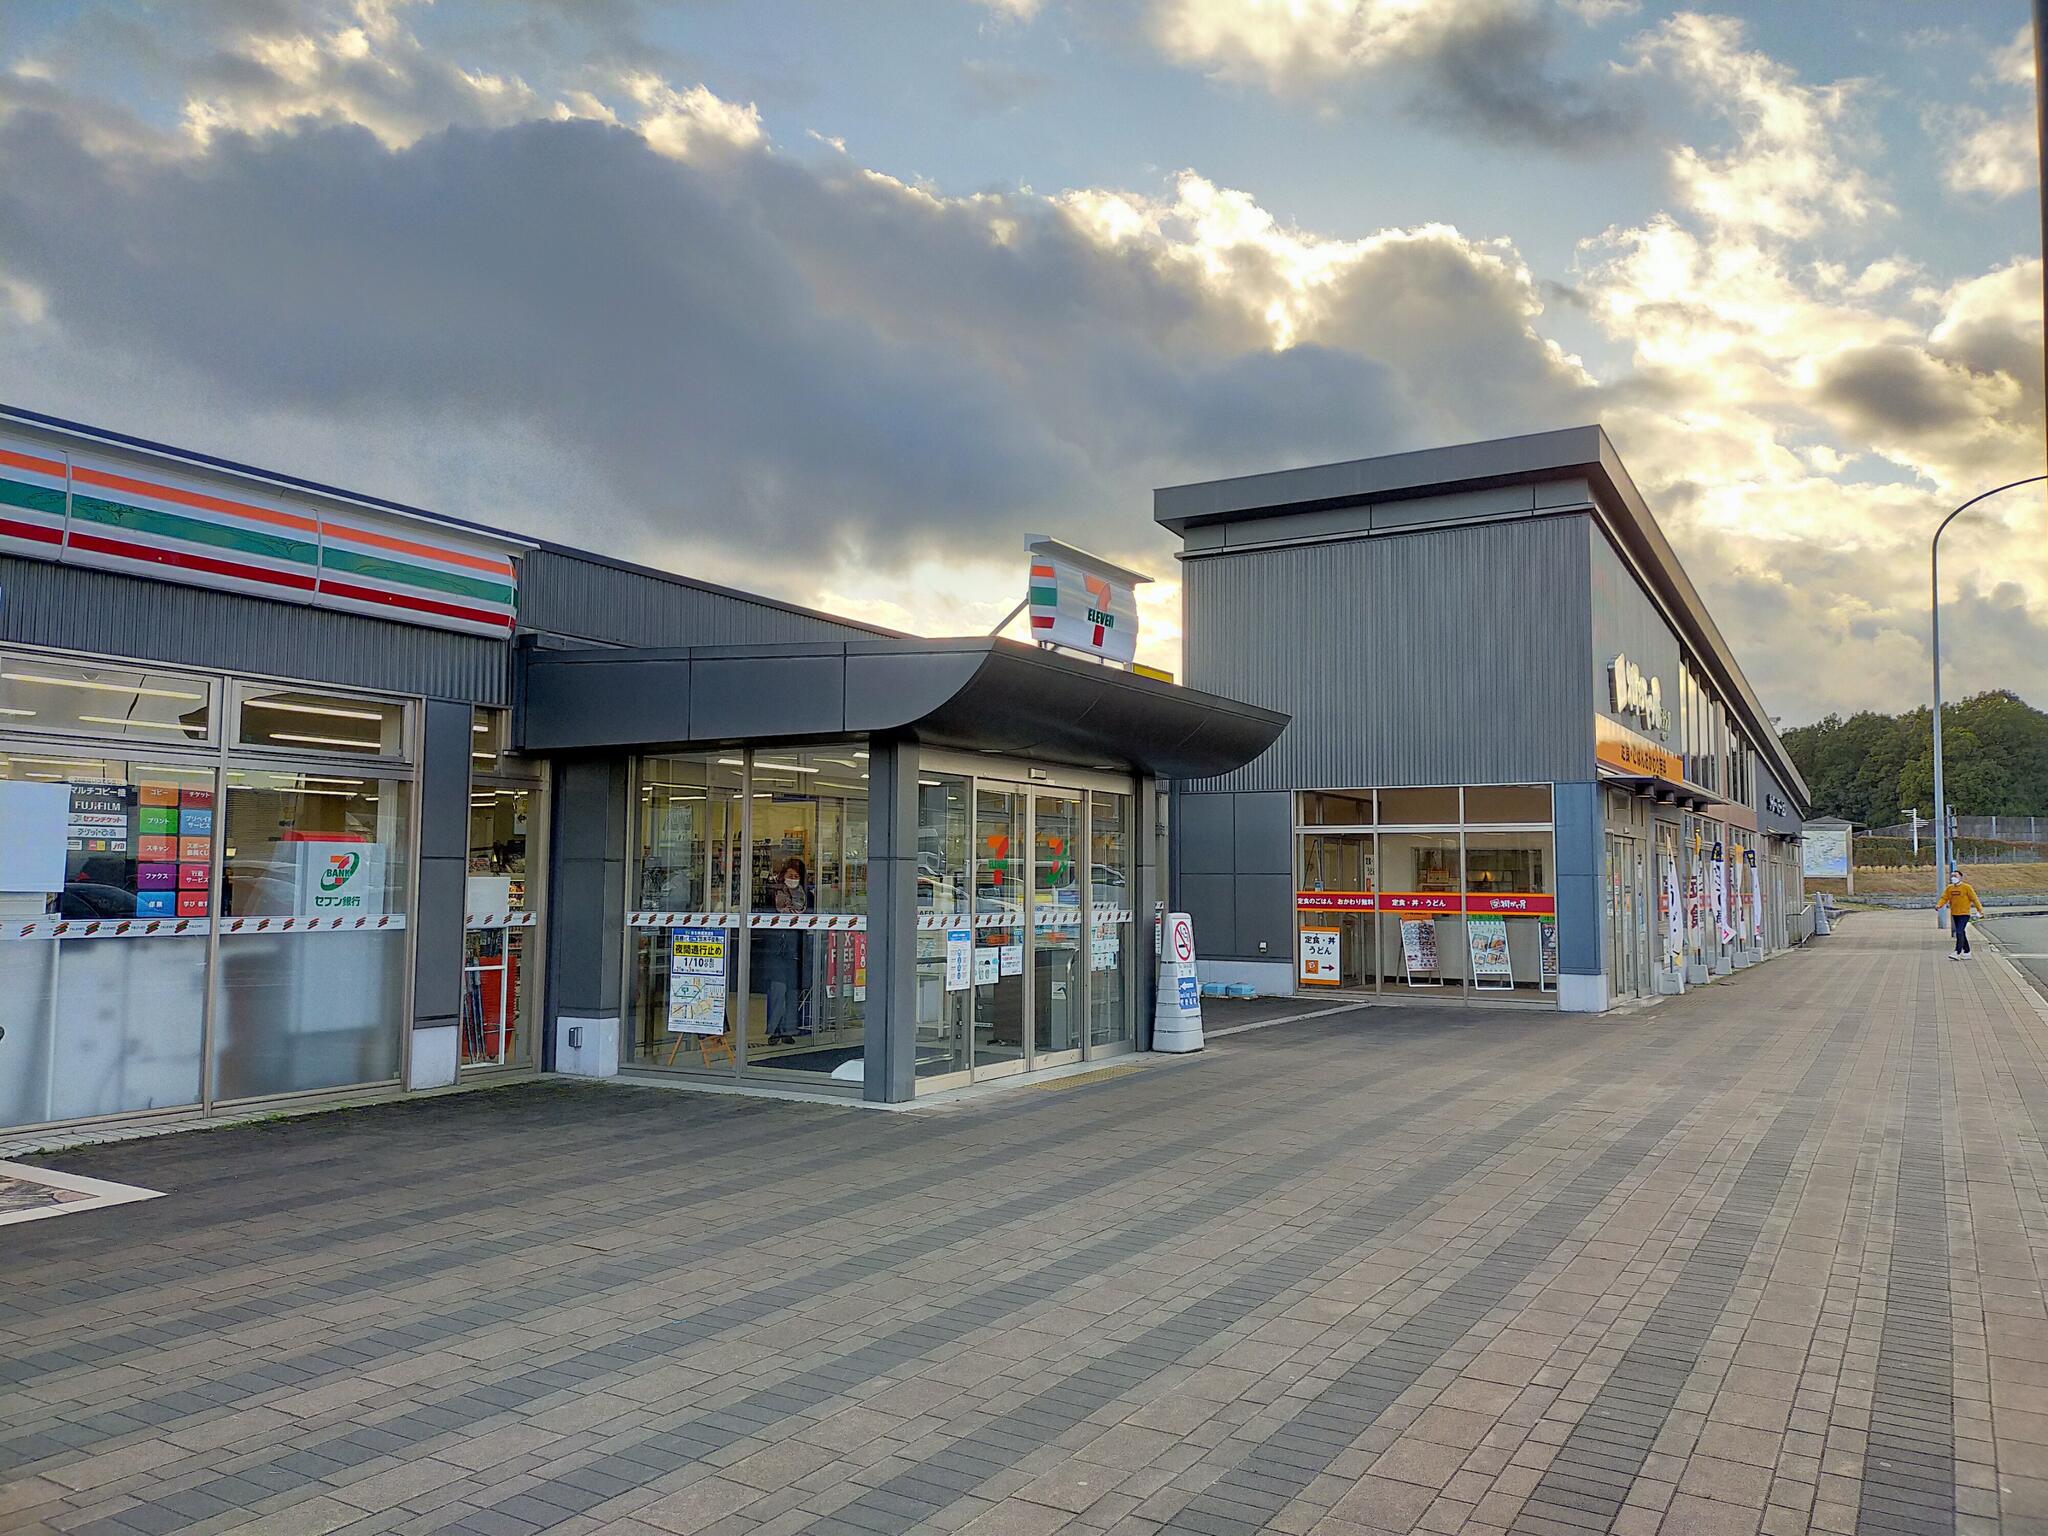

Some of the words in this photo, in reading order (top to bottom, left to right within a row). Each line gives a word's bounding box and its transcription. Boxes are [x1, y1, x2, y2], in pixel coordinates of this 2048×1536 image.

[326, 868, 351, 878] BANK
[315, 895, 361, 907] セブン銀行
[1308, 946, 1332, 955] うどん
